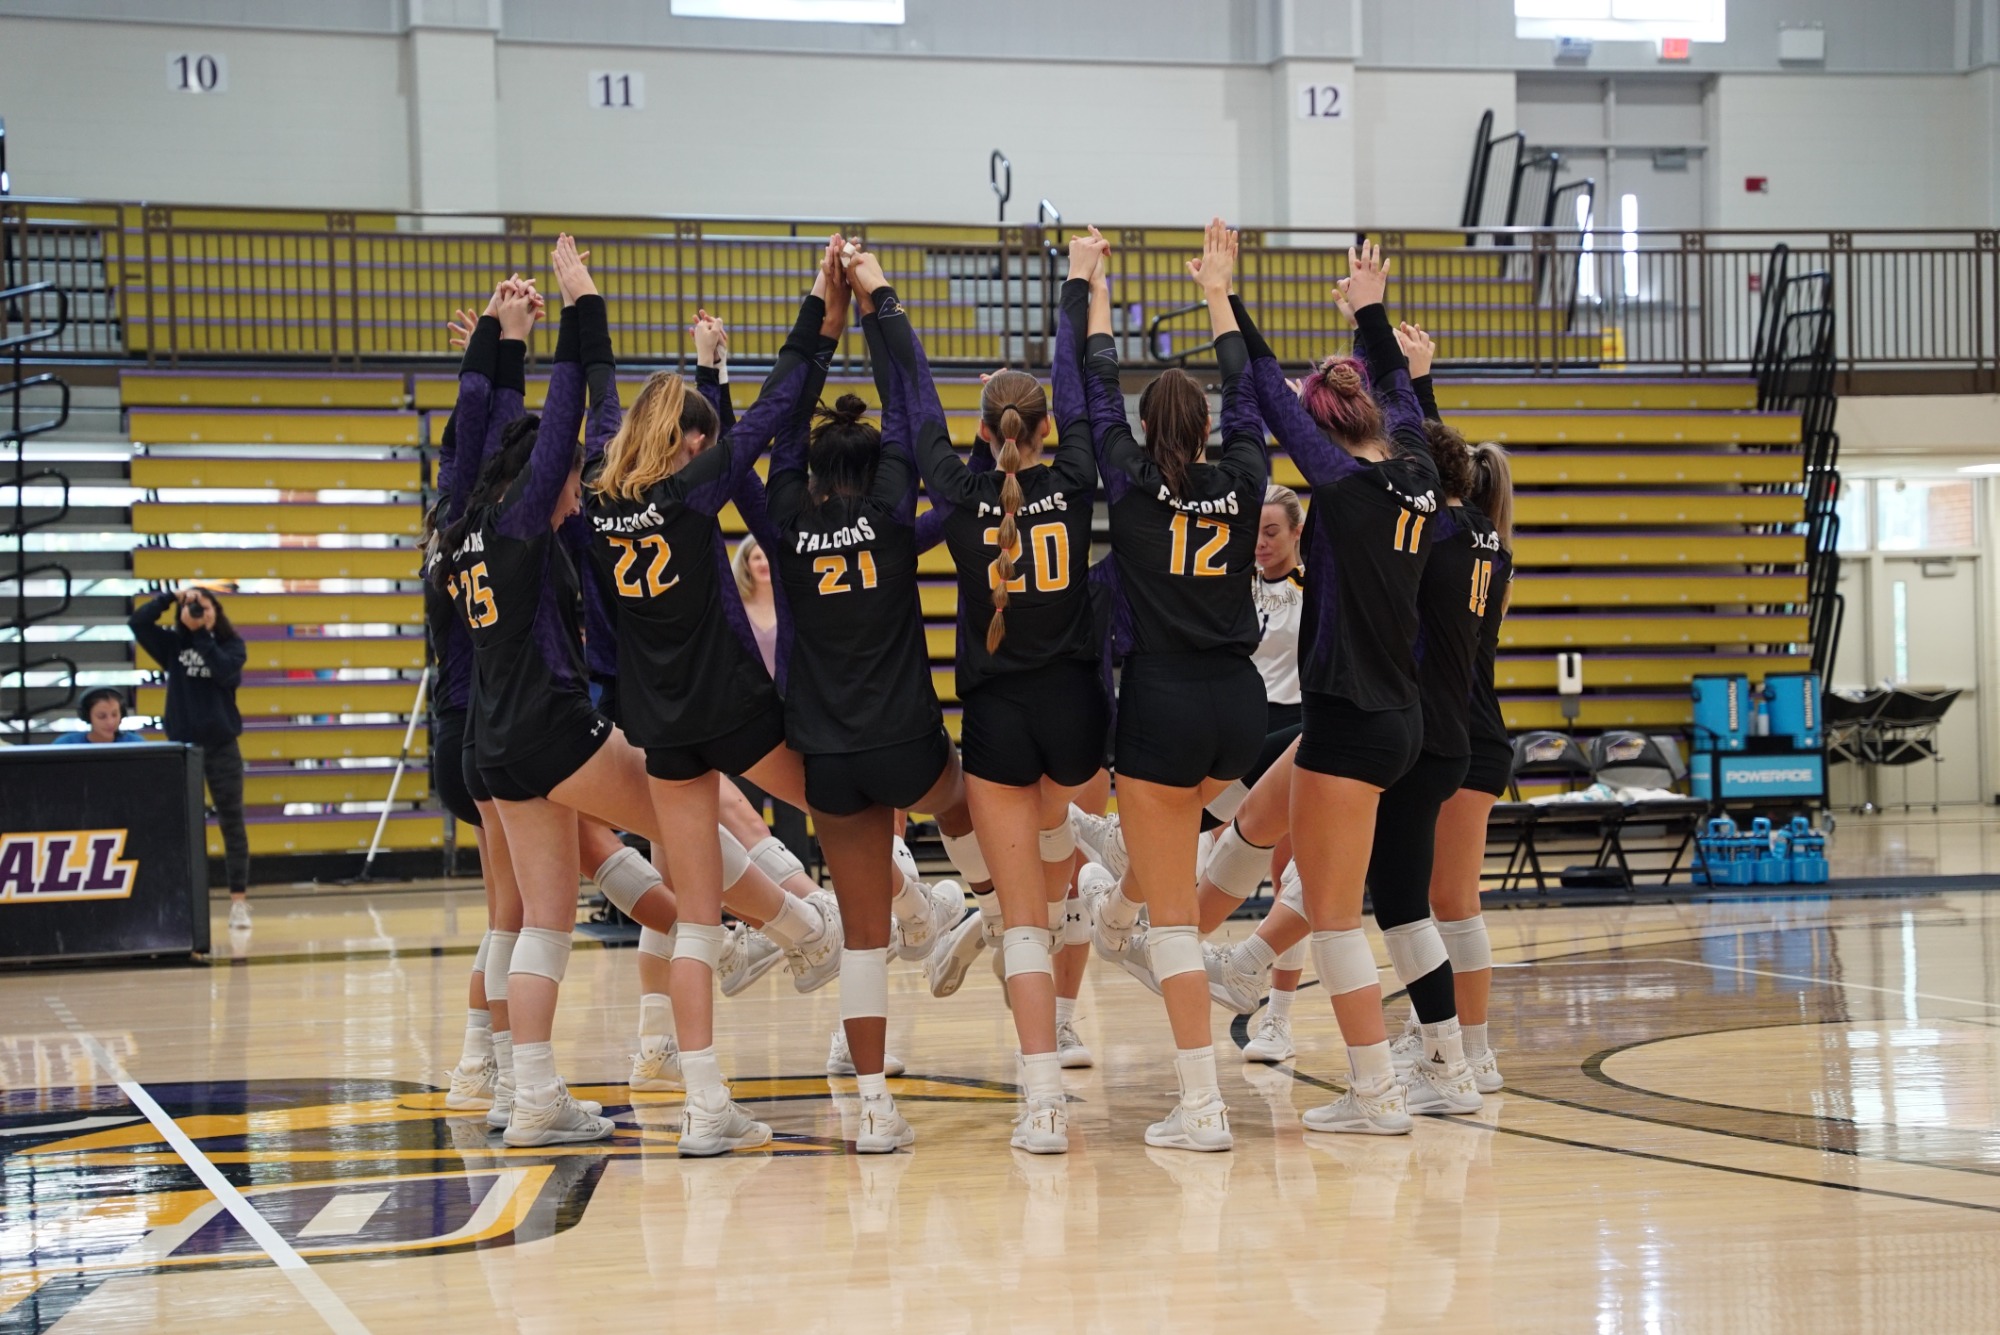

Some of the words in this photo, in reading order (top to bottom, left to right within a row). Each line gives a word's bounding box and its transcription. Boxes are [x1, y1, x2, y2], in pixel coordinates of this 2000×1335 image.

[173, 54, 218, 91] 10
[596, 73, 635, 107] 11
[1301, 85, 1342, 117] 12
[977, 492, 1068, 518] FACONS
[795, 516, 876, 555] FALCONS
[1168, 510, 1231, 577] 12
[1393, 506, 1426, 554] 11
[606, 533, 680, 598] 22
[812, 550, 878, 596] 21
[983, 521, 1070, 594] 20
